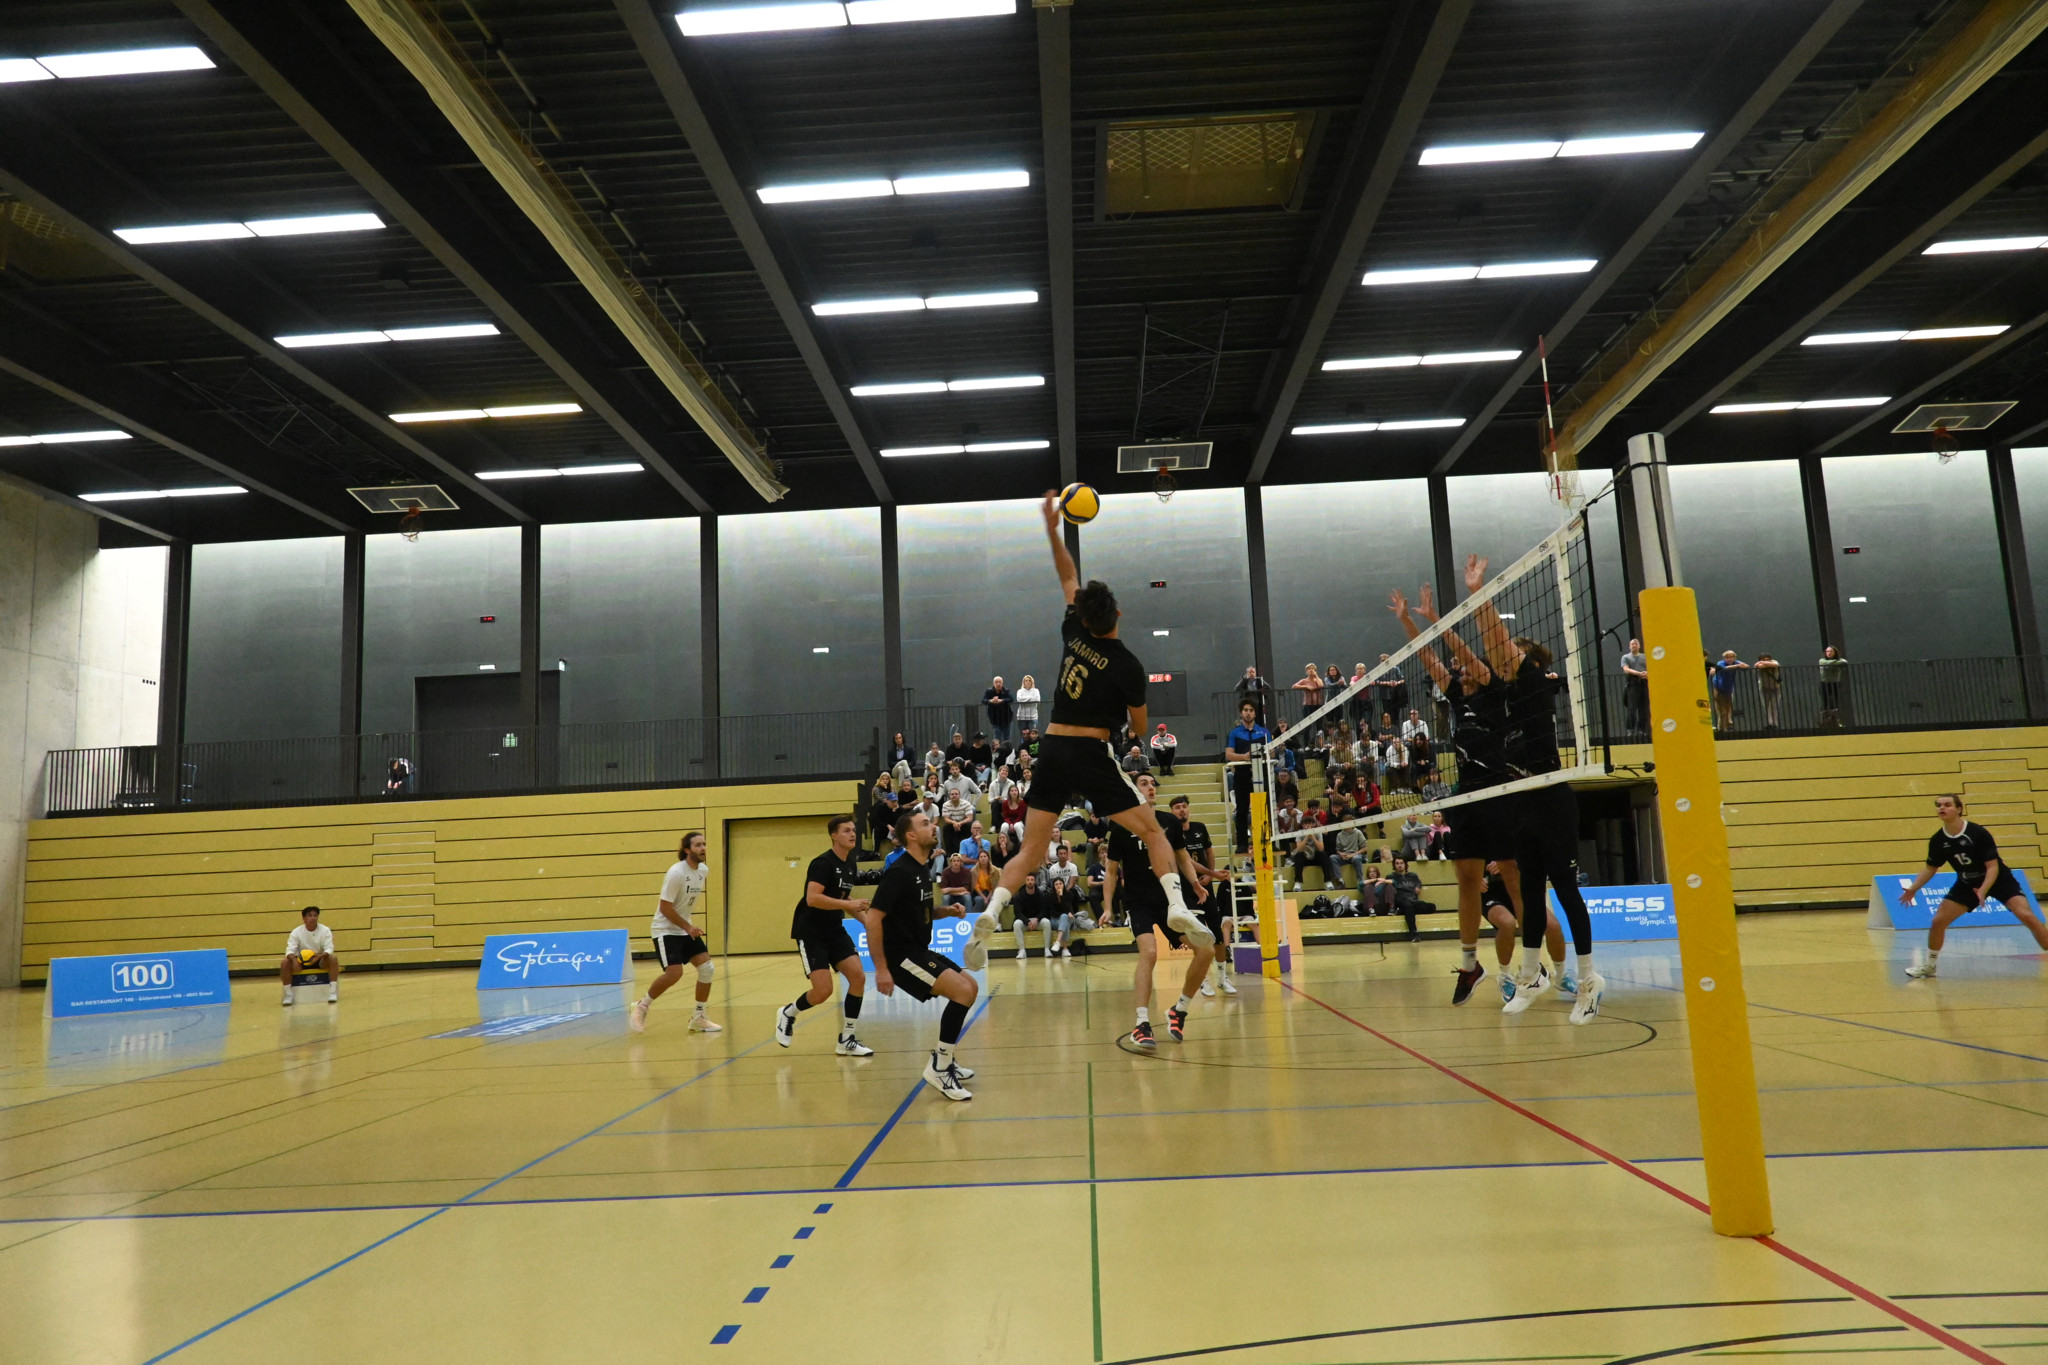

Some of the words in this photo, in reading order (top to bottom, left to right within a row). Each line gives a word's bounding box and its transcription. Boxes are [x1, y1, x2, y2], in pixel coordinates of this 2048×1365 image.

[1067, 637, 1109, 670] JAMIRO
[1060, 655, 1089, 700] 16
[1954, 852, 1972, 865] 15
[1921, 887, 1951, 896] Bäumli
[1588, 906, 1624, 914] klinik
[1631, 914, 1648, 922] swiss
[1640, 918, 1666, 927] olympic
[496, 940, 604, 979] Eptinger
[116, 963, 168, 988] 100
[85, 998, 123, 1006] RESTAURANT
